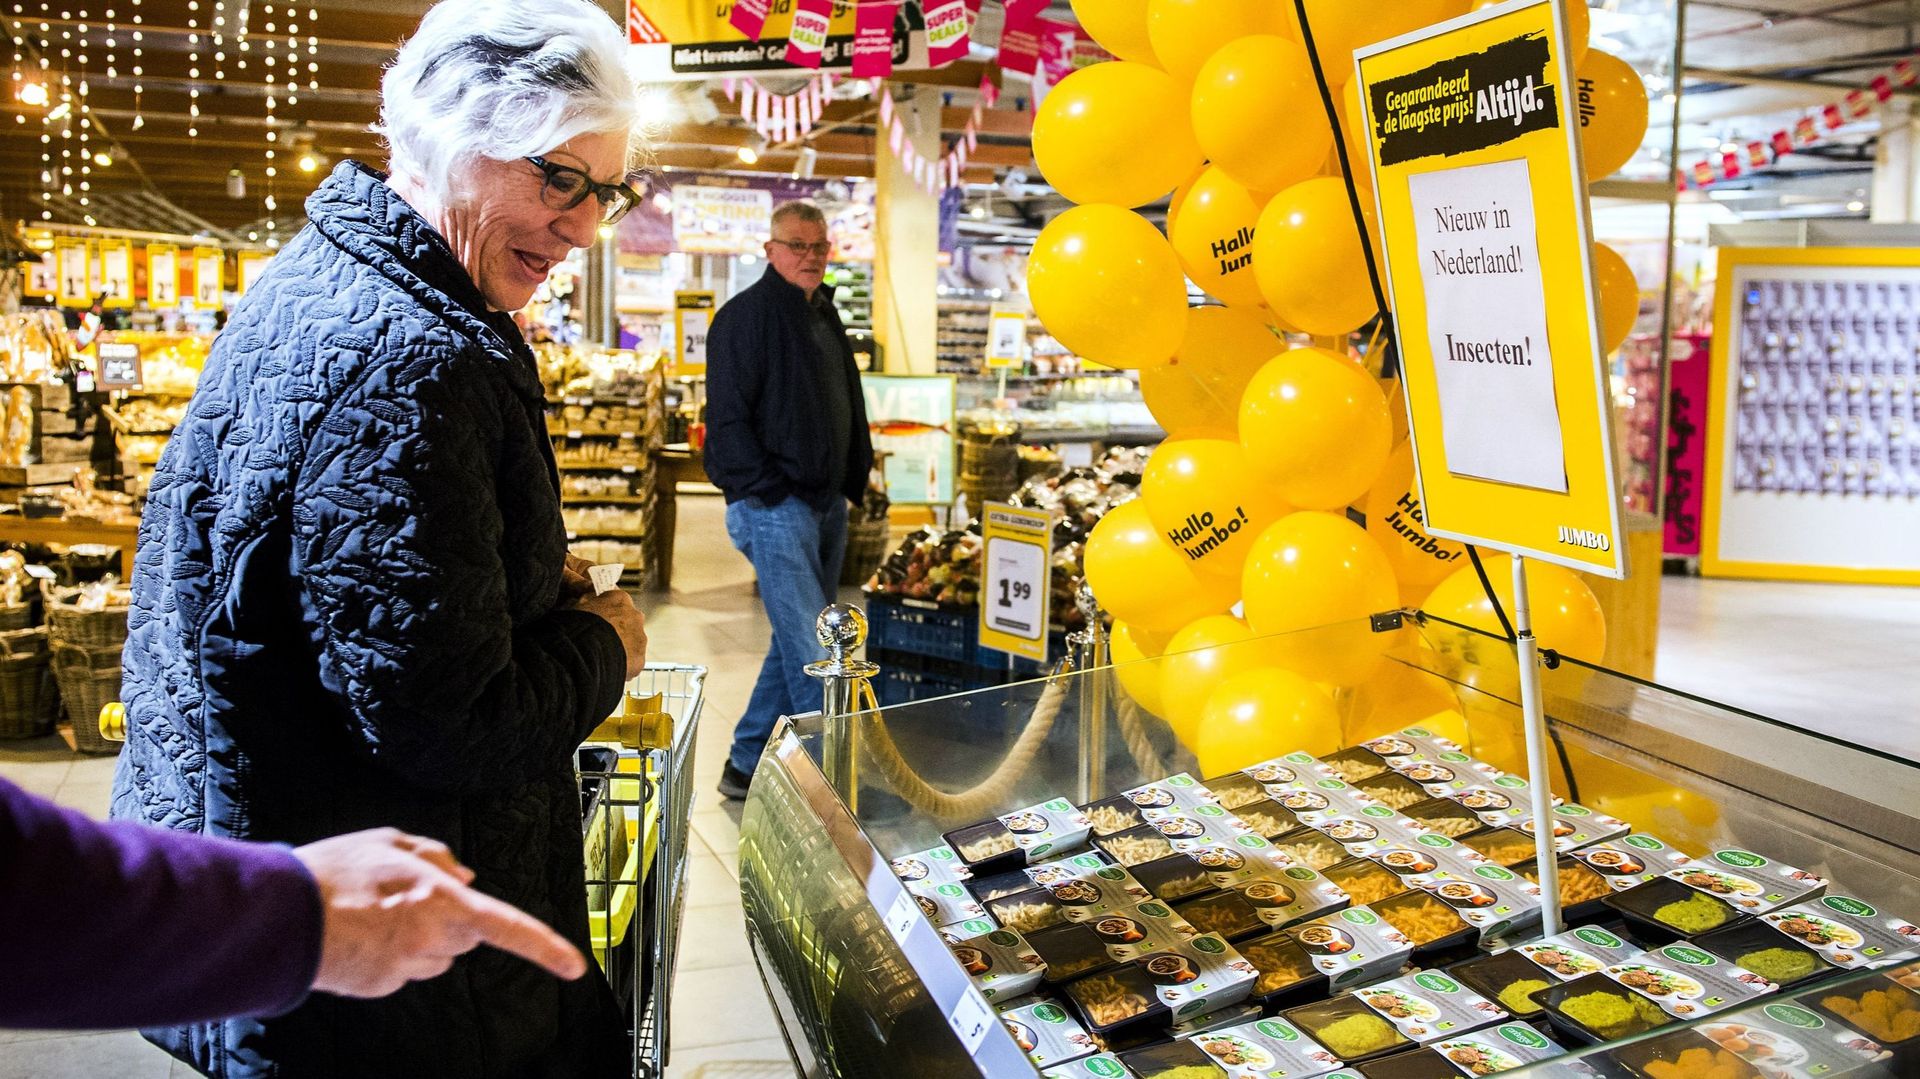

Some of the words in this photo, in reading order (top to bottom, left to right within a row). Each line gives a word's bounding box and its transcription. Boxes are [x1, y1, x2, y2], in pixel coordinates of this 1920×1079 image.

[796, 16, 827, 33] SUPER
[928, 7, 964, 29] SUPER
[929, 21, 965, 42] DEALS
[793, 29, 823, 46] DEALS
[1384, 113, 1398, 134] de
[1399, 104, 1441, 133] laagste
[1443, 92, 1474, 127] prijs!
[1476, 75, 1544, 126] Altijd.
[1386, 69, 1469, 115] Gegarandeerd
[1578, 79, 1596, 127] Hallo
[1434, 205, 1487, 233] Nieuw
[1493, 201, 1511, 229] in
[1432, 245, 1523, 275] Nederland!
[1445, 334, 1531, 366] Insecten!
[865, 386, 947, 422] VET
[1396, 491, 1424, 527] Ha
[1168, 511, 1214, 546] Hallo
[1385, 511, 1462, 563] Jumbo!
[1559, 525, 1610, 552] JUMBO
